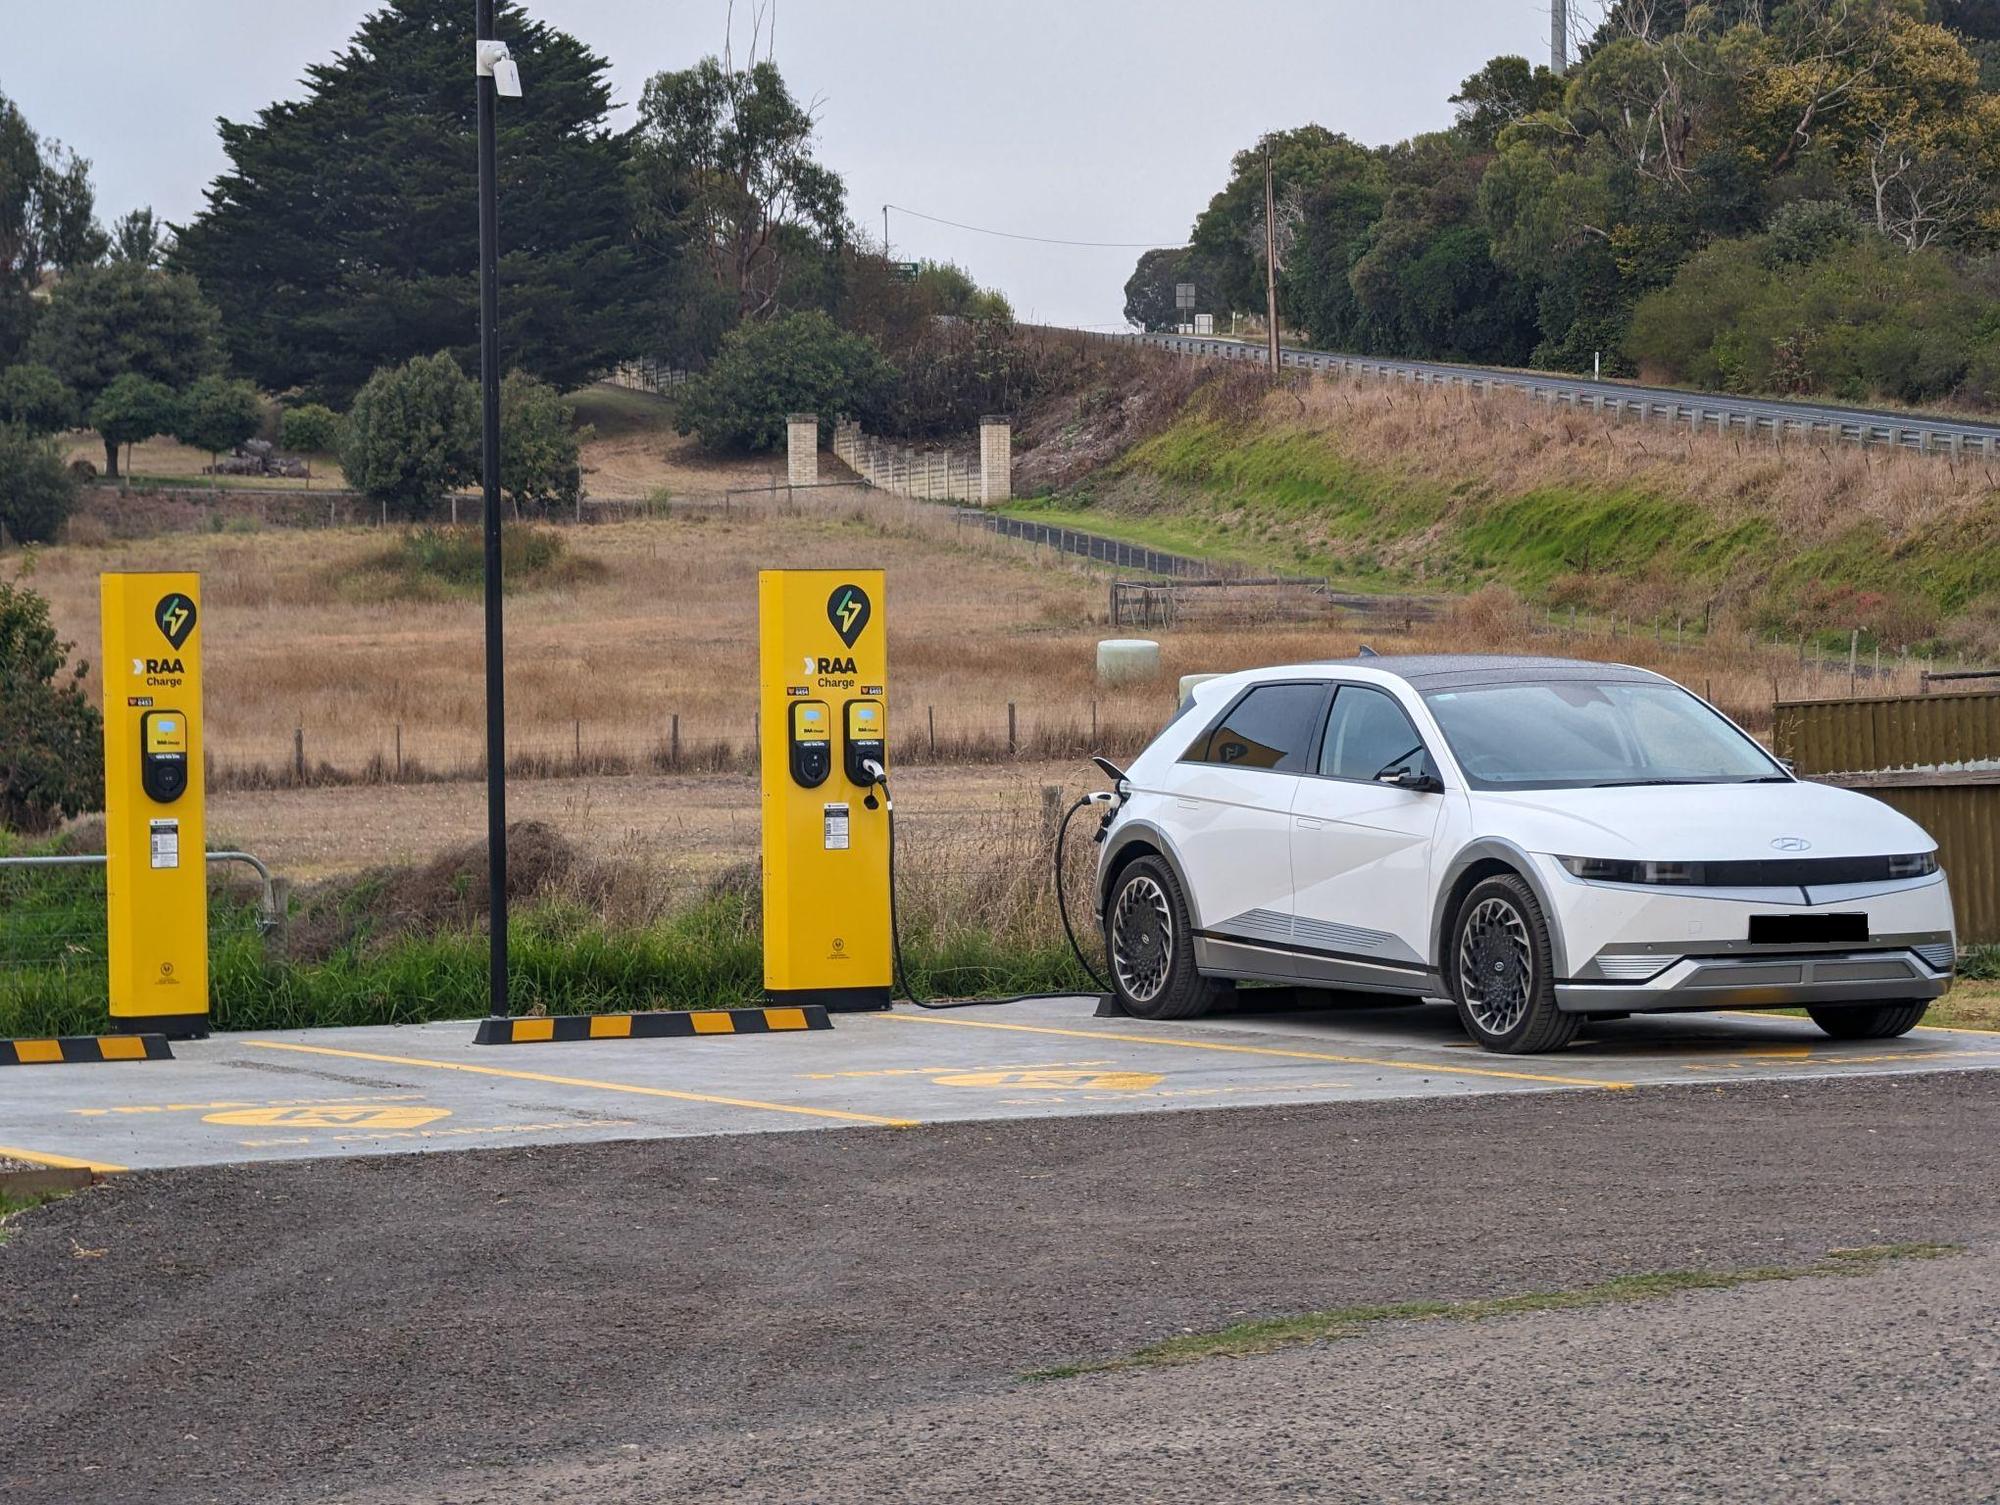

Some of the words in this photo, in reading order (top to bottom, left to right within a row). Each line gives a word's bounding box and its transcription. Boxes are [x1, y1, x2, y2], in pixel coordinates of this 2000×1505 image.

[146, 658, 185, 674] RAA
[817, 657, 857, 674] RAA
[146, 677, 182, 688] Charge
[818, 678, 855, 689] Charge
